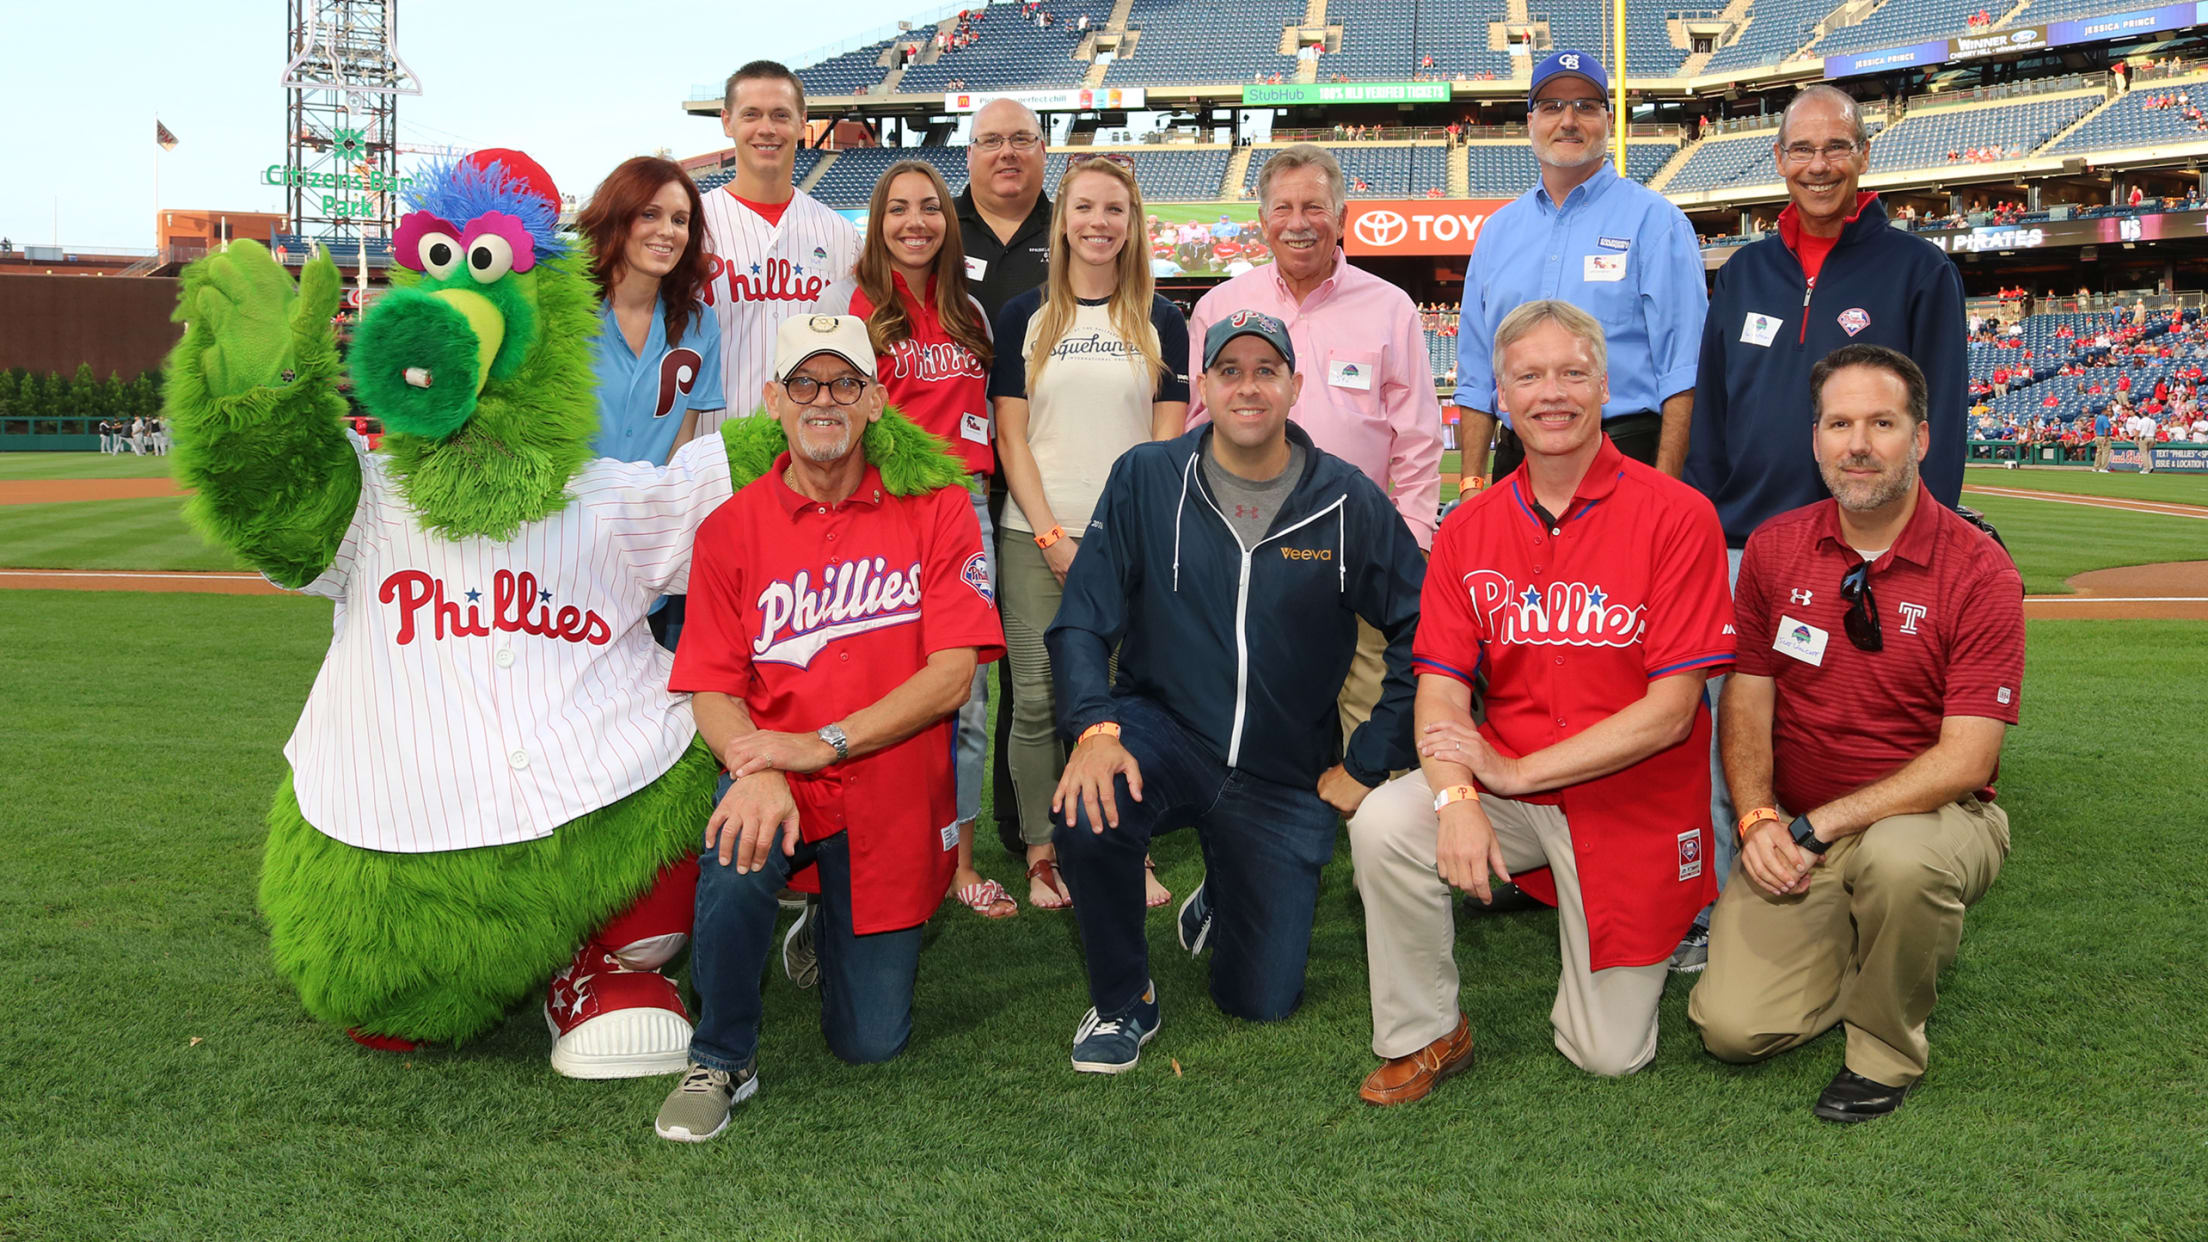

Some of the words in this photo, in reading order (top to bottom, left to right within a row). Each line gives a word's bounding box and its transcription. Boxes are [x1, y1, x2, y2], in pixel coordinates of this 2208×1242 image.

[2084, 22, 2120, 36] JESSICA
[2123, 16, 2156, 28] PRINCE
[1958, 37, 2007, 51] WINNER
[1856, 57, 1885, 69] JESSICA
[1887, 53, 1915, 63] PRINCE
[1049, 95, 1067, 104] chill
[1249, 89, 1305, 101] StubHub
[1407, 85, 1444, 98] TICKETS
[266, 165, 363, 191] Citizens
[322, 195, 375, 217] Park
[1412, 214, 1492, 241] TOY
[2119, 219, 2141, 240] VS
[1952, 229, 2043, 252] PIRATES
[702, 252, 831, 308] Phillie
[889, 339, 985, 382] Phillie
[654, 348, 703, 418] P
[1280, 547, 1332, 560] Veeva
[379, 569, 612, 645] Phillies
[752, 556, 922, 655] Phillies
[1899, 602, 1927, 635] T
